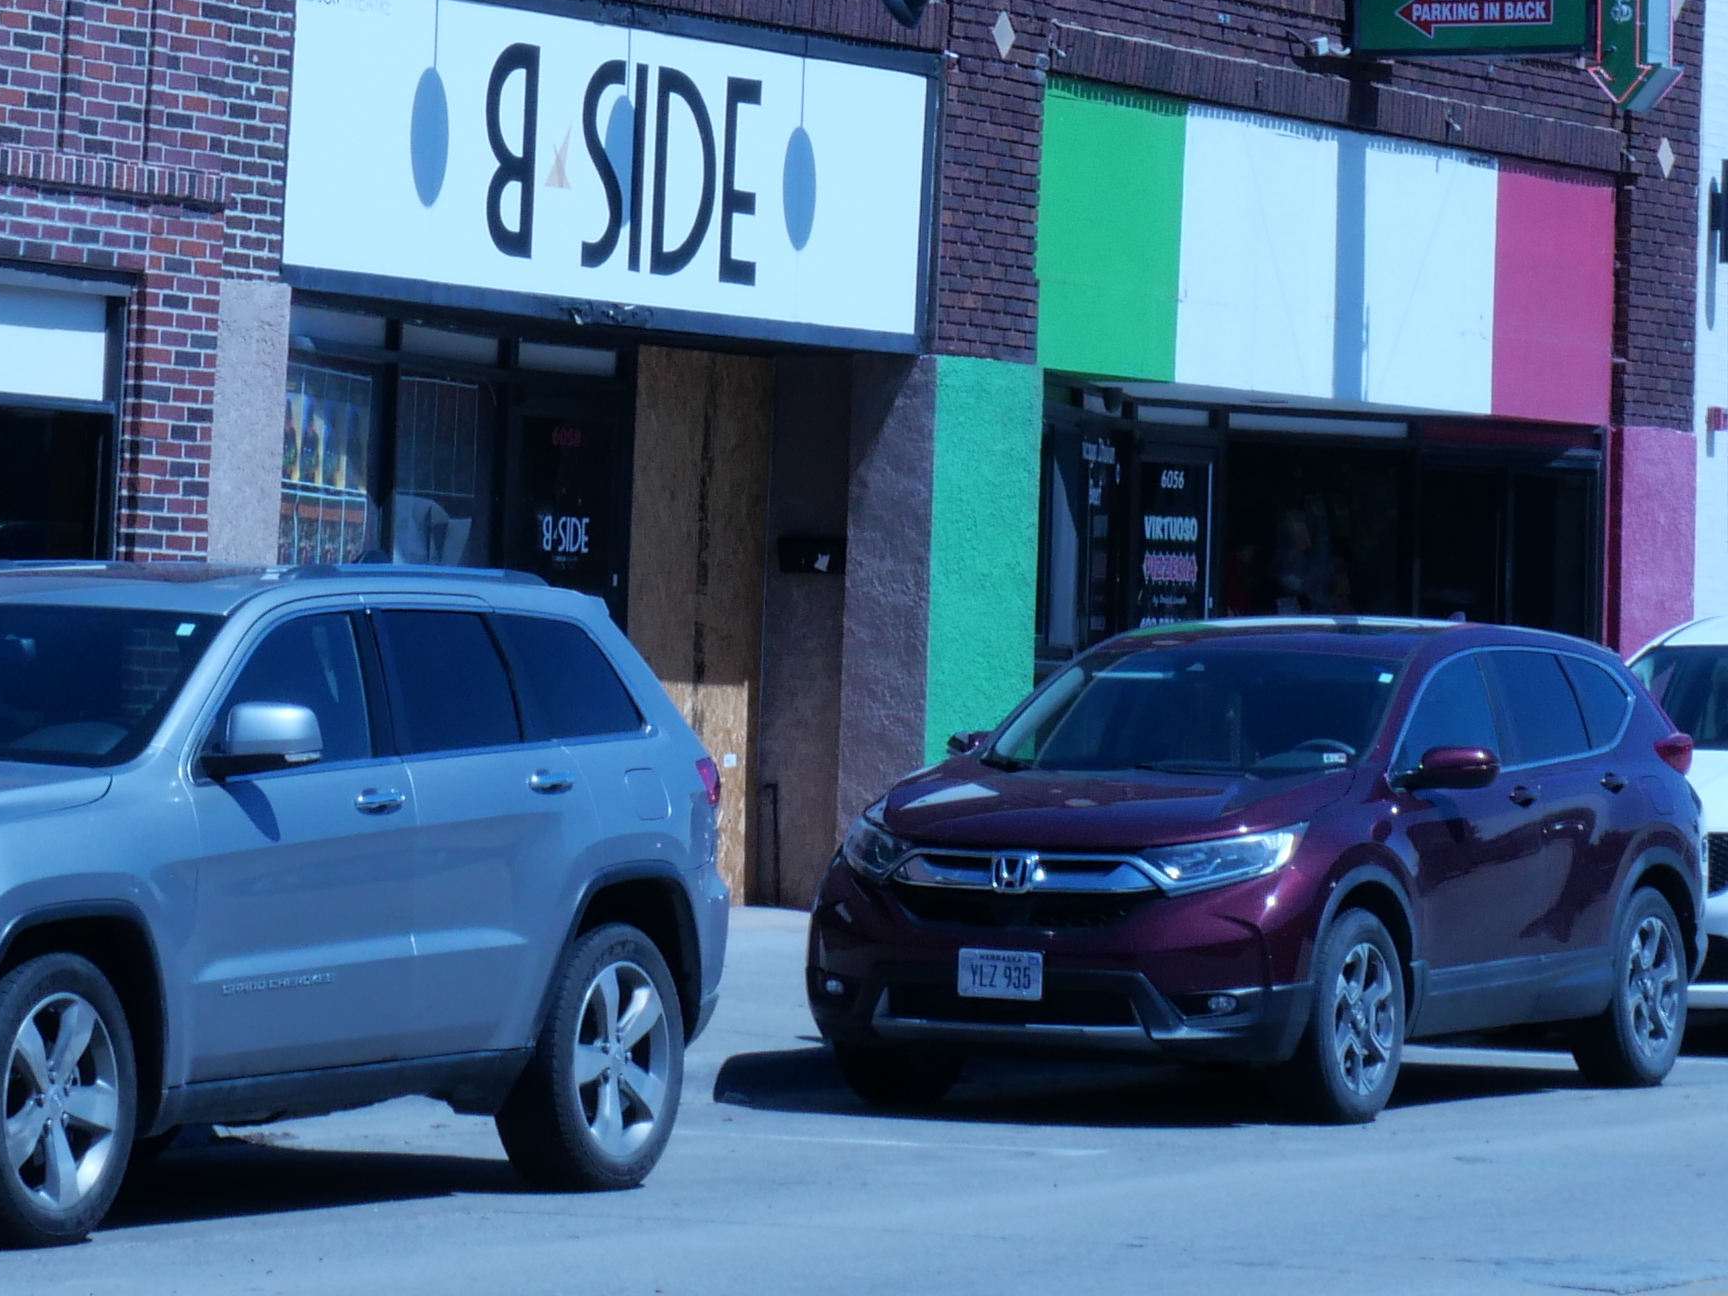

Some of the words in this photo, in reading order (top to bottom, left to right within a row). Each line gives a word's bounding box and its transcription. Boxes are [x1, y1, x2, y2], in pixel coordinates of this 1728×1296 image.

[1411, 2, 1480, 22] PARKING
[1483, 2, 1501, 21] IN
[1504, 1, 1547, 20] BACK
[1160, 469, 1185, 490] 6056
[1143, 514, 1199, 542] VIRTUOSO
[1144, 555, 1198, 582] PIZZERIA
[970, 962, 997, 988] YLZ
[1003, 966, 1032, 990] 935
